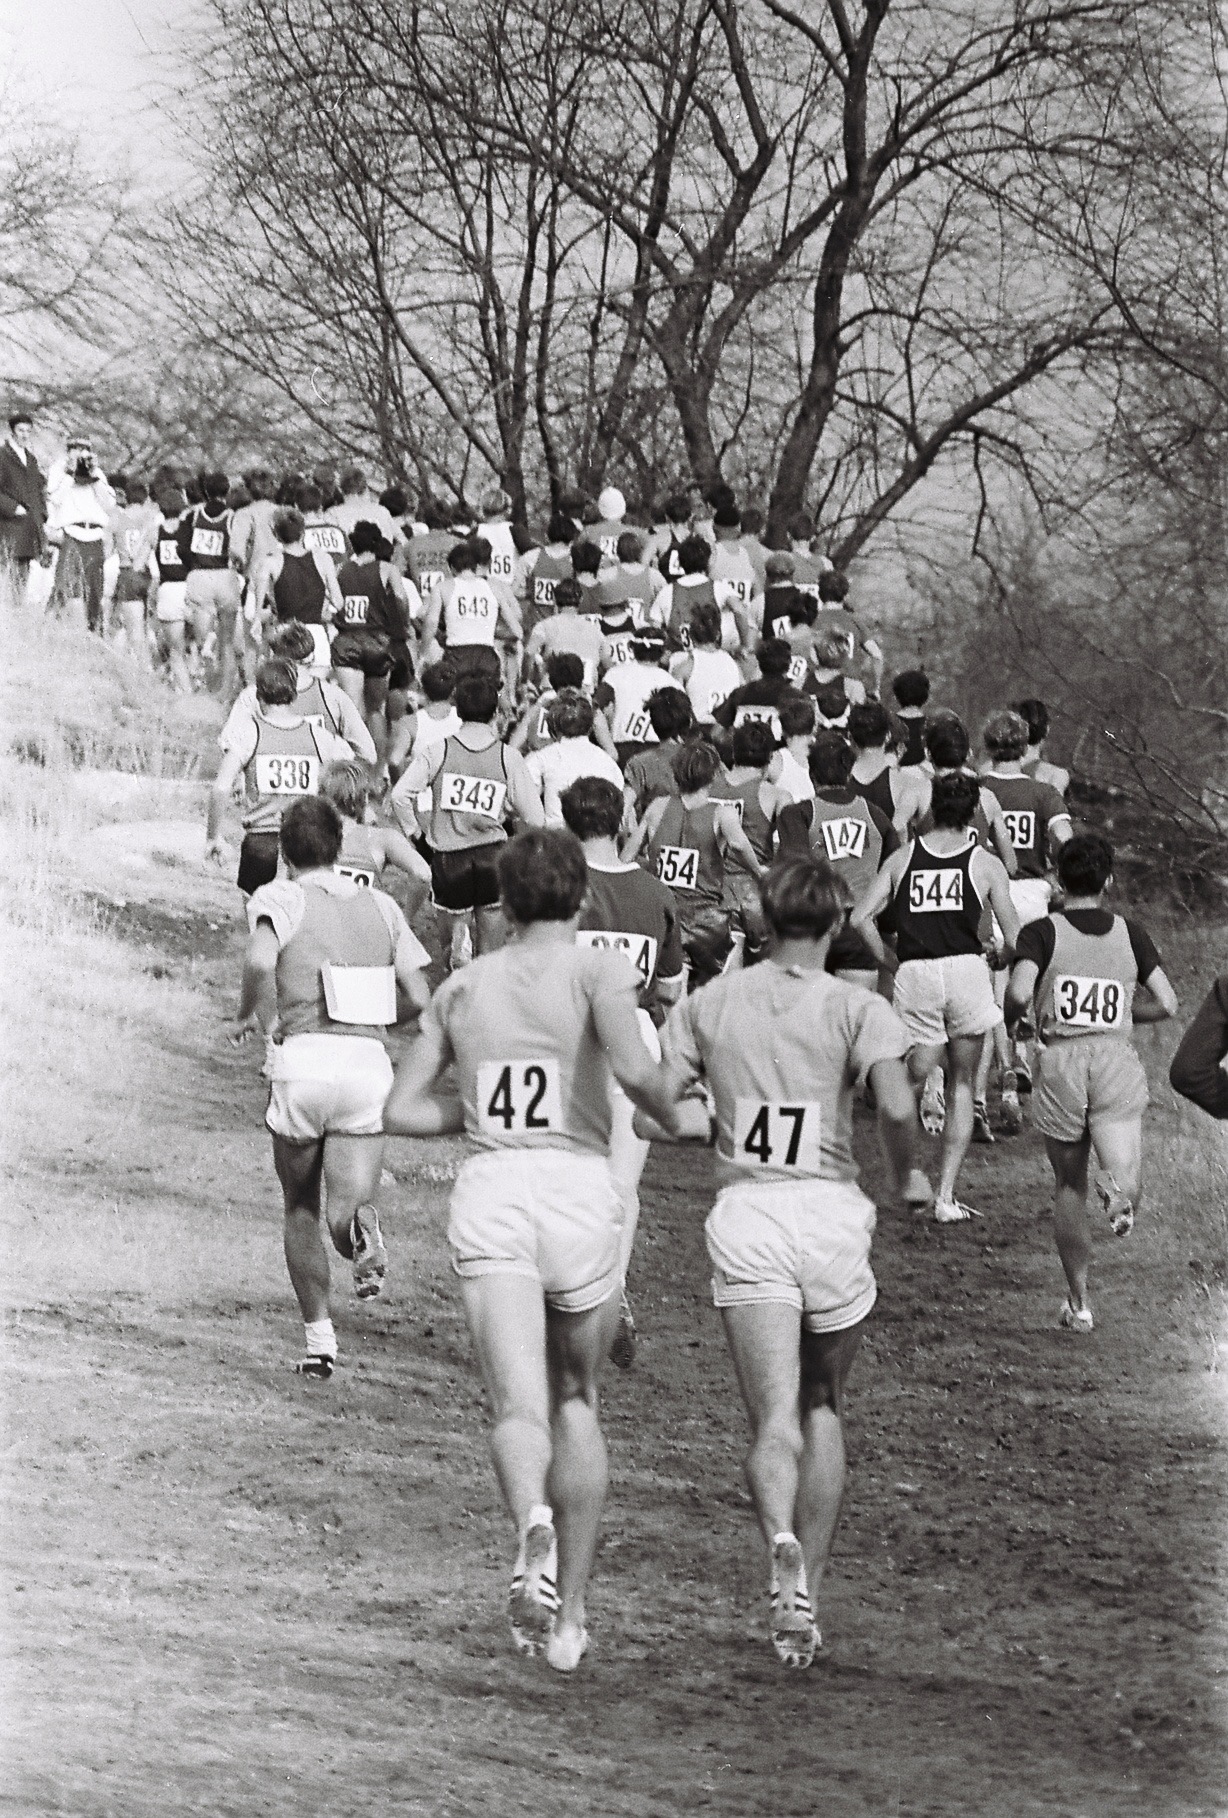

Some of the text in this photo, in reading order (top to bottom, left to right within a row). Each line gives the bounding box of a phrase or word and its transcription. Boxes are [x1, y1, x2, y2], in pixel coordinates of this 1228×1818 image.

[311, 530, 340, 548] 366
[346, 597, 367, 620] 80
[457, 596, 489, 617] 643
[268, 758, 311, 790] 338
[449, 777, 497, 812] 343
[826, 820, 863, 855] 147
[909, 872, 962, 909] 544
[1059, 979, 1120, 1024] 348
[486, 1064, 550, 1131] 42
[744, 1104, 807, 1166] 47
